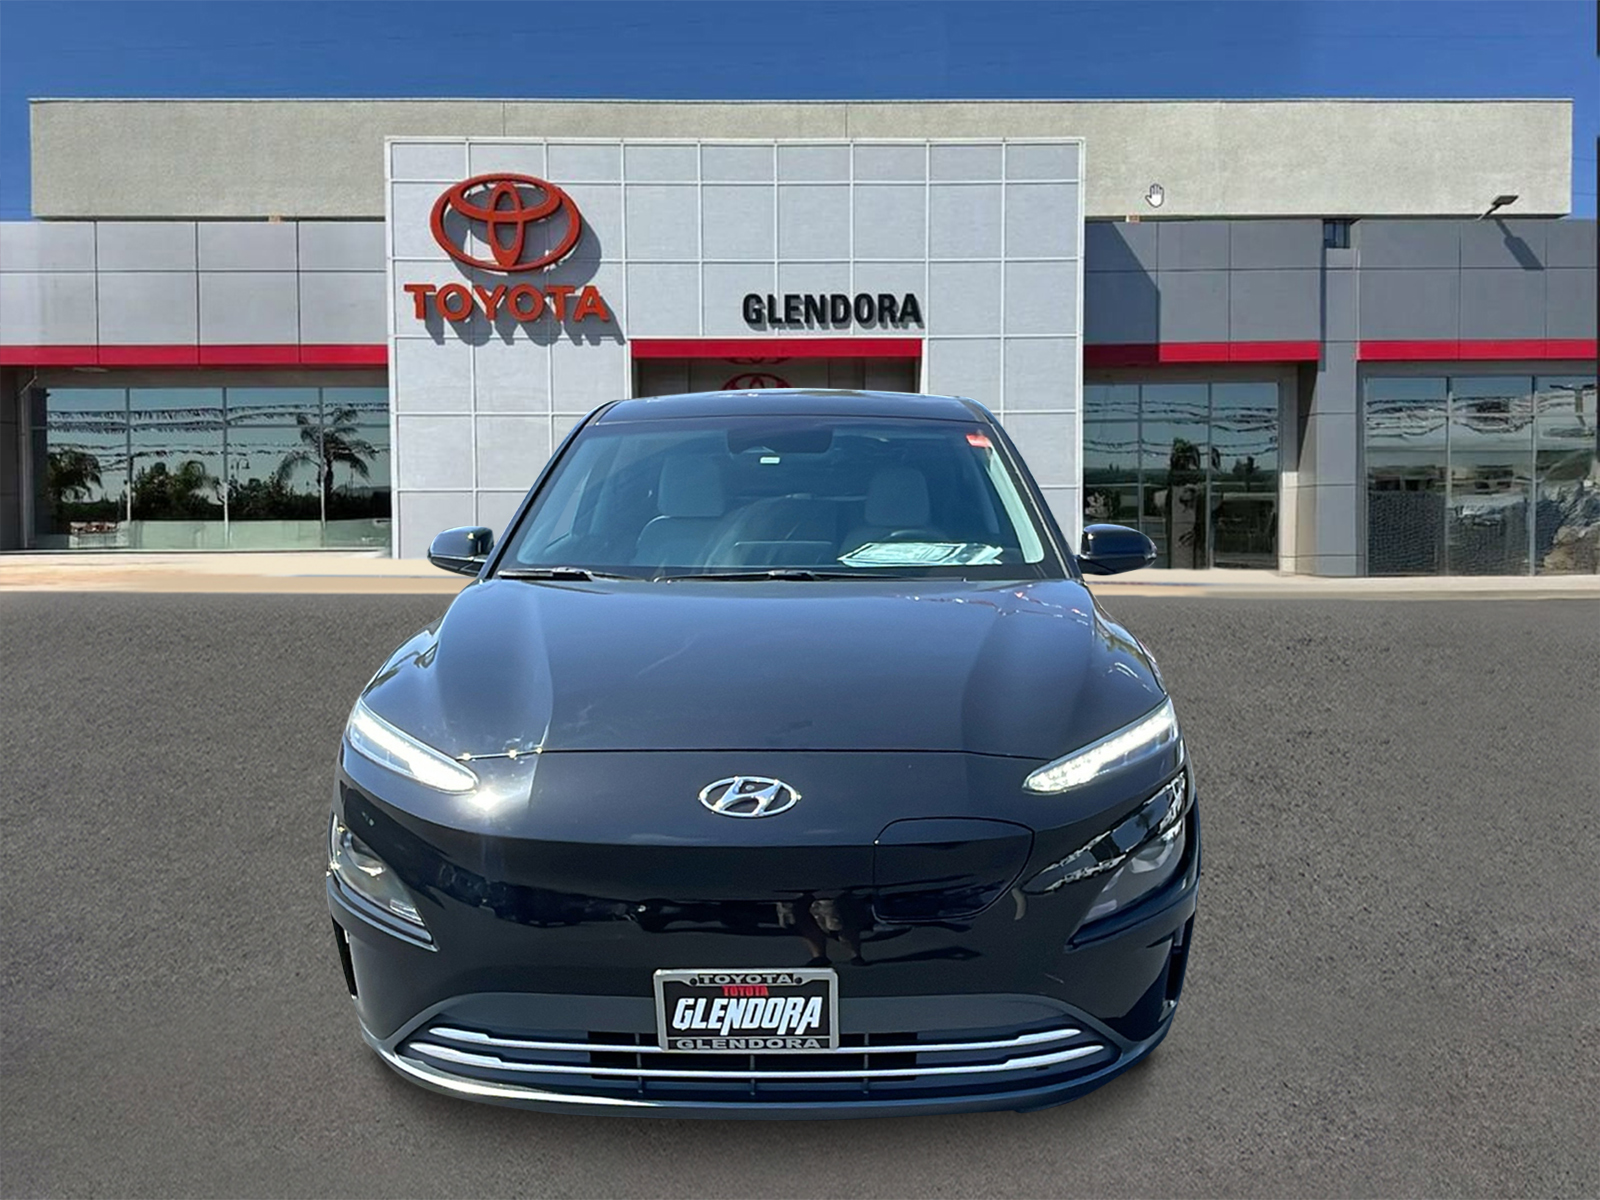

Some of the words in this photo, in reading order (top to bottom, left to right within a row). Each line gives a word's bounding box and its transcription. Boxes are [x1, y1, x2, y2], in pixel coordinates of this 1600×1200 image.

[404, 283, 610, 323] TOYOTA
[742, 293, 922, 325] GLENDORA
[699, 974, 792, 985] TOYOTA
[722, 985, 769, 997] TOYOTA
[672, 997, 823, 1036] GLENDORA
[676, 1038, 821, 1050] GLENDORA
